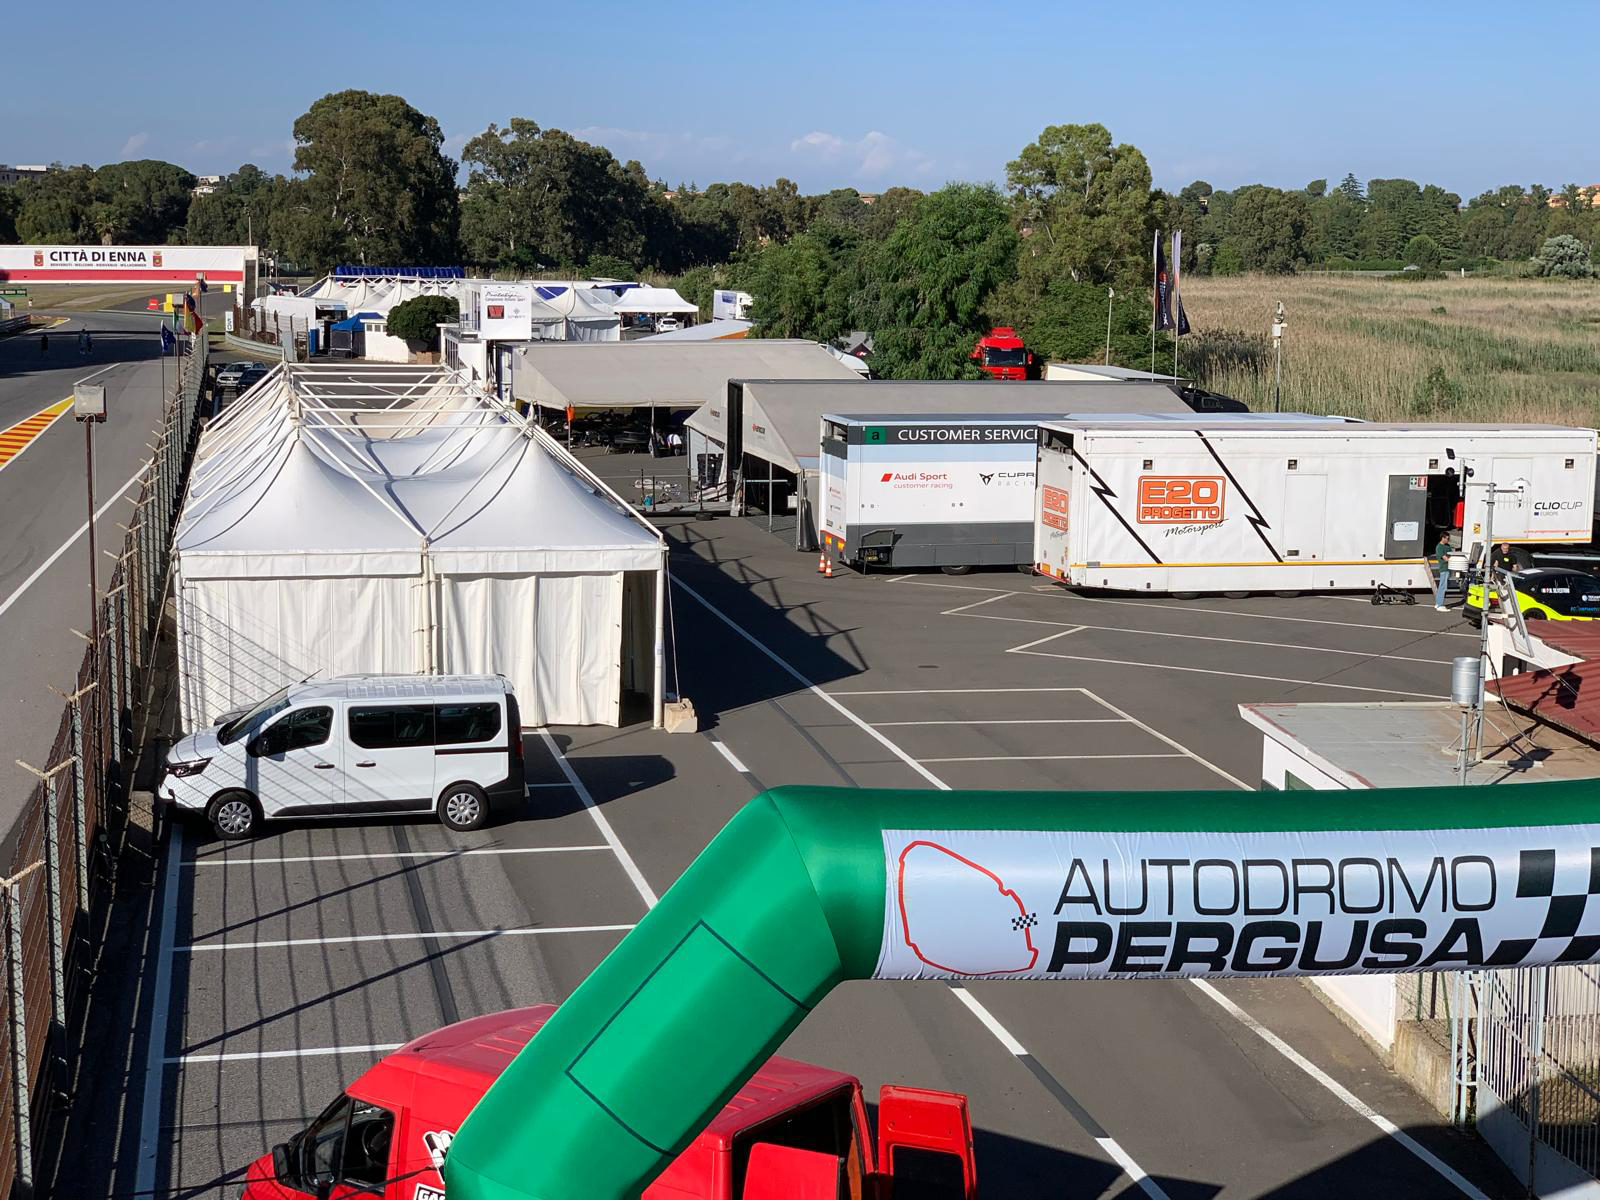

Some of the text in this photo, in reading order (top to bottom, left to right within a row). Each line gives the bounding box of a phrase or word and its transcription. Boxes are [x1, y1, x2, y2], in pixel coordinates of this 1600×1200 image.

[50, 249, 147, 262] CITTÀ DI ENNA
[898, 429, 980, 441] CUSTOMER
[894, 472, 948, 482] Audi Sport
[1141, 480, 1219, 505] E20
[1141, 506, 1220, 520] PROGETTO
[1163, 518, 1229, 538] Motorsport
[1053, 854, 1496, 916] AUTODROMO
[1047, 917, 1484, 974] PERGUSA
